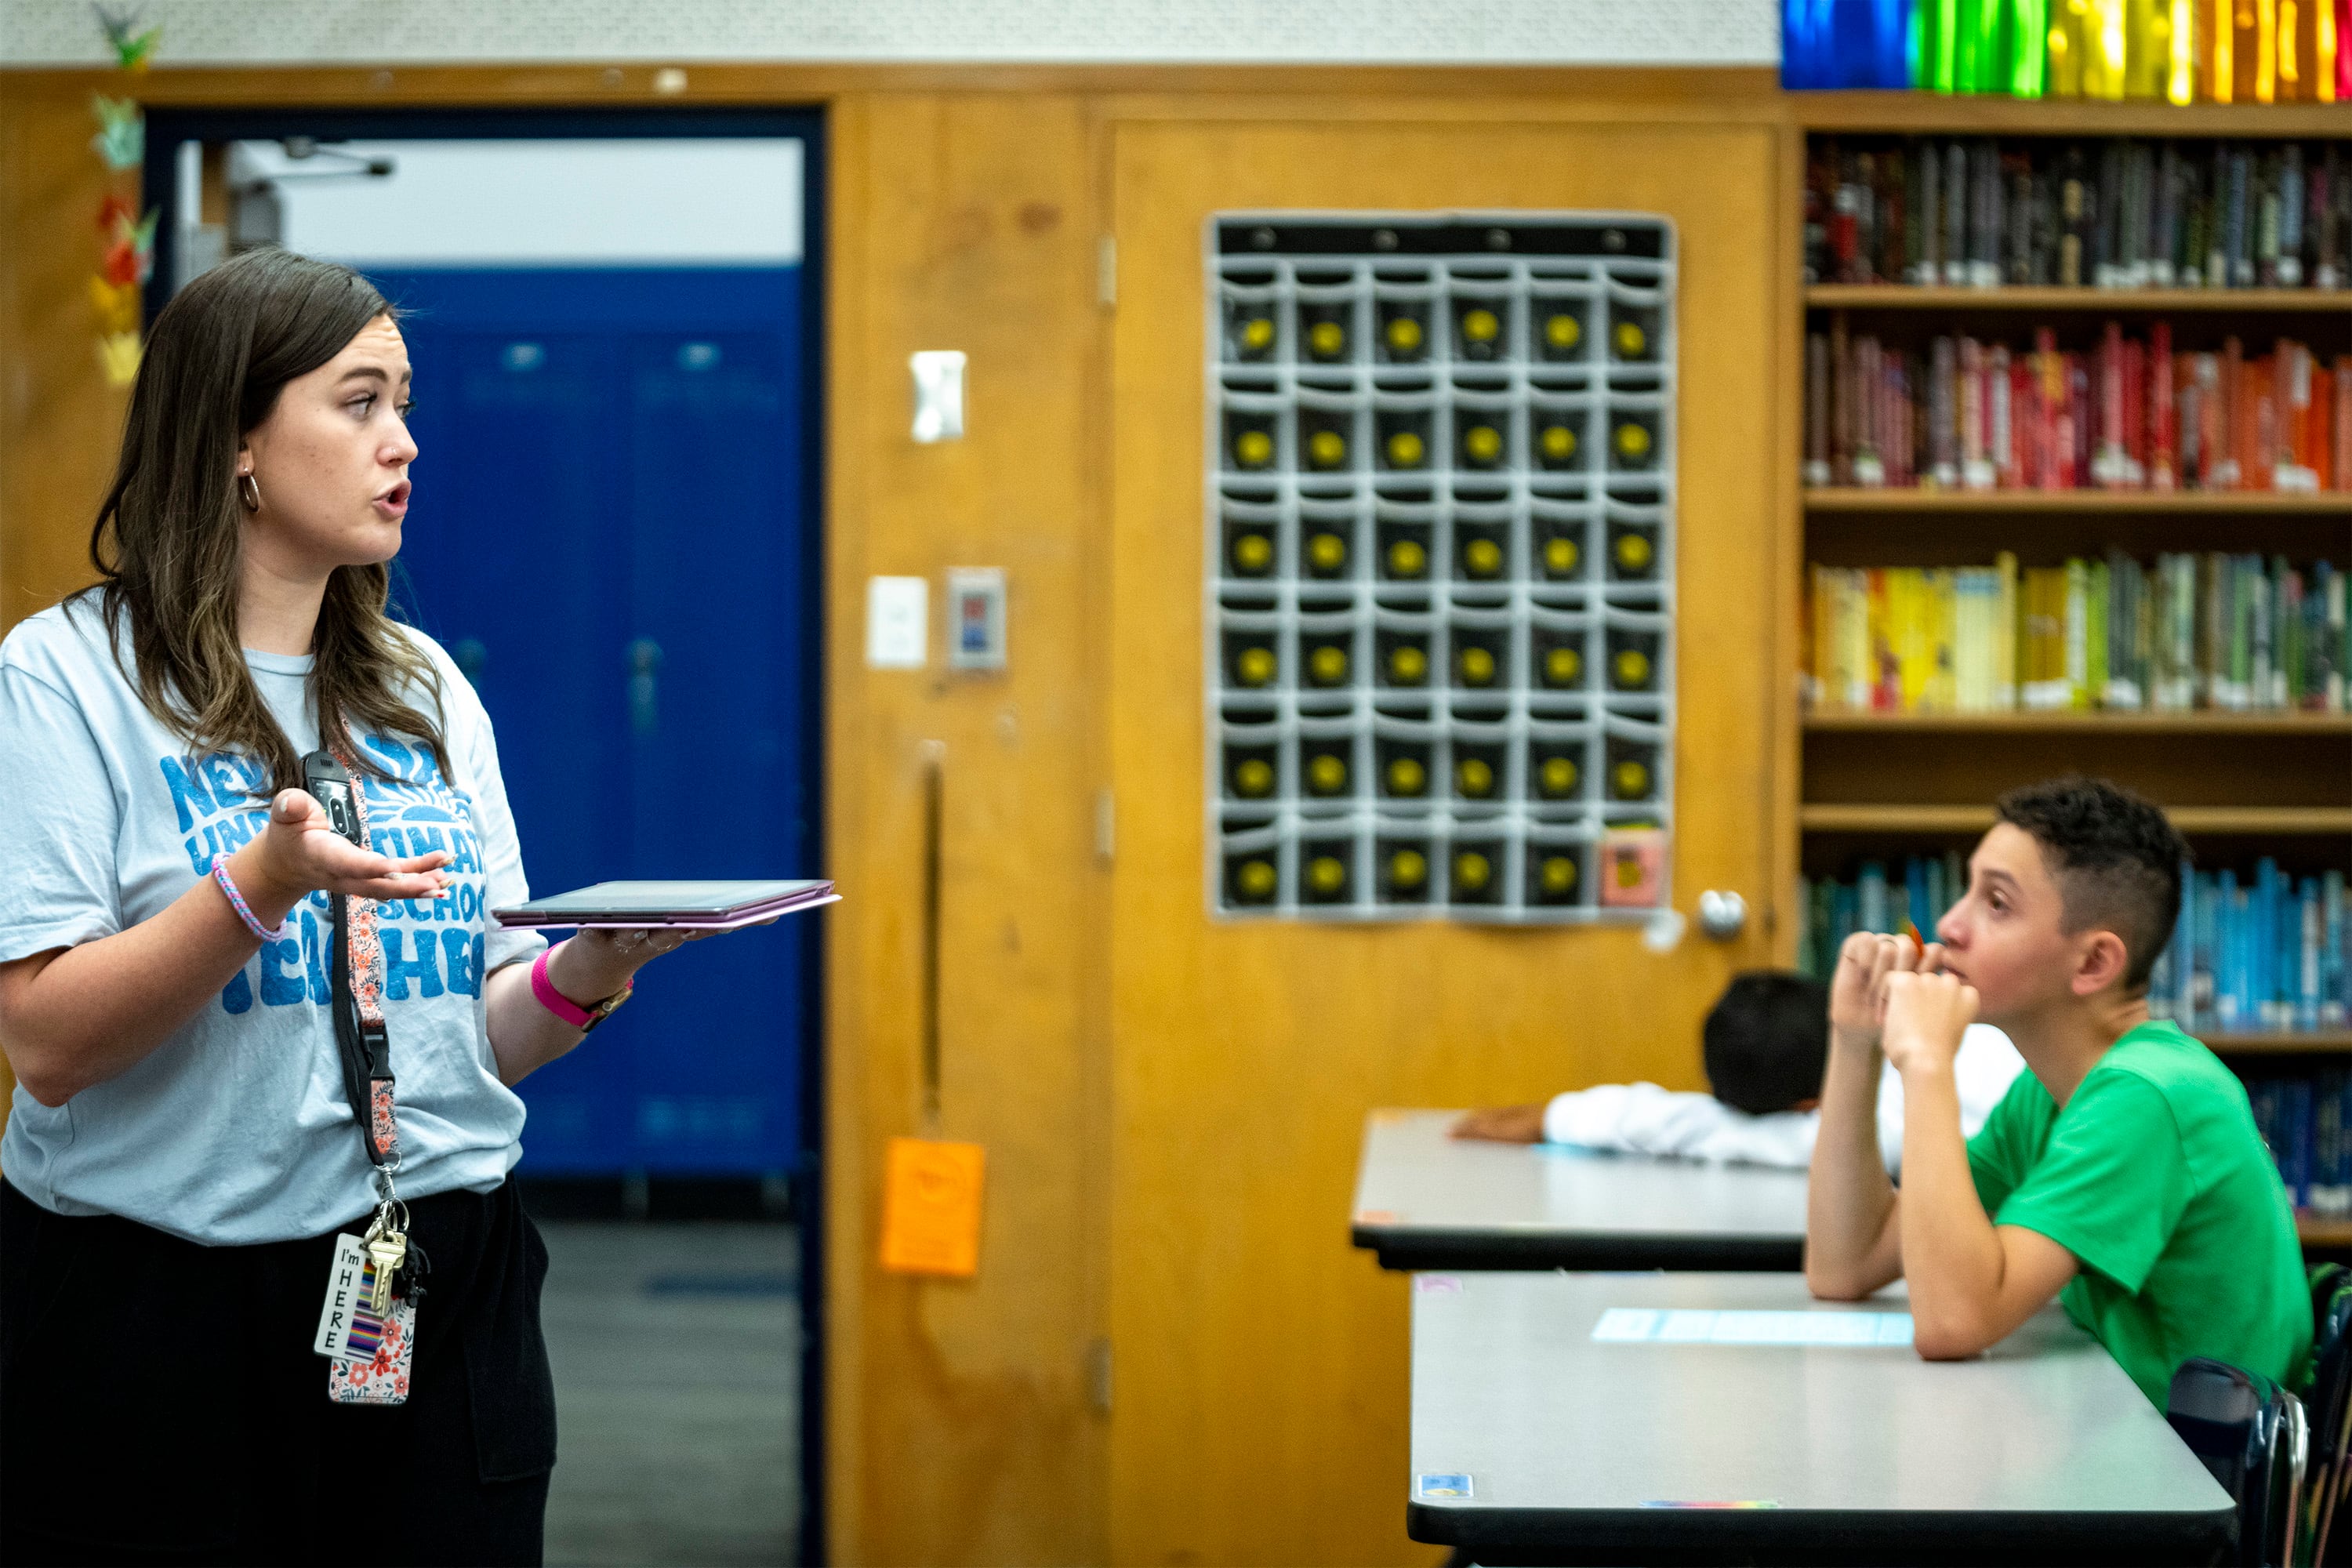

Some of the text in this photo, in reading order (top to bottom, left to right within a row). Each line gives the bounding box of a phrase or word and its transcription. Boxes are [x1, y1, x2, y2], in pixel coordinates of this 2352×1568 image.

[160, 752, 274, 834] NEV
[222, 907, 485, 1014] EAHE
[341, 1248, 360, 1266] I'm
